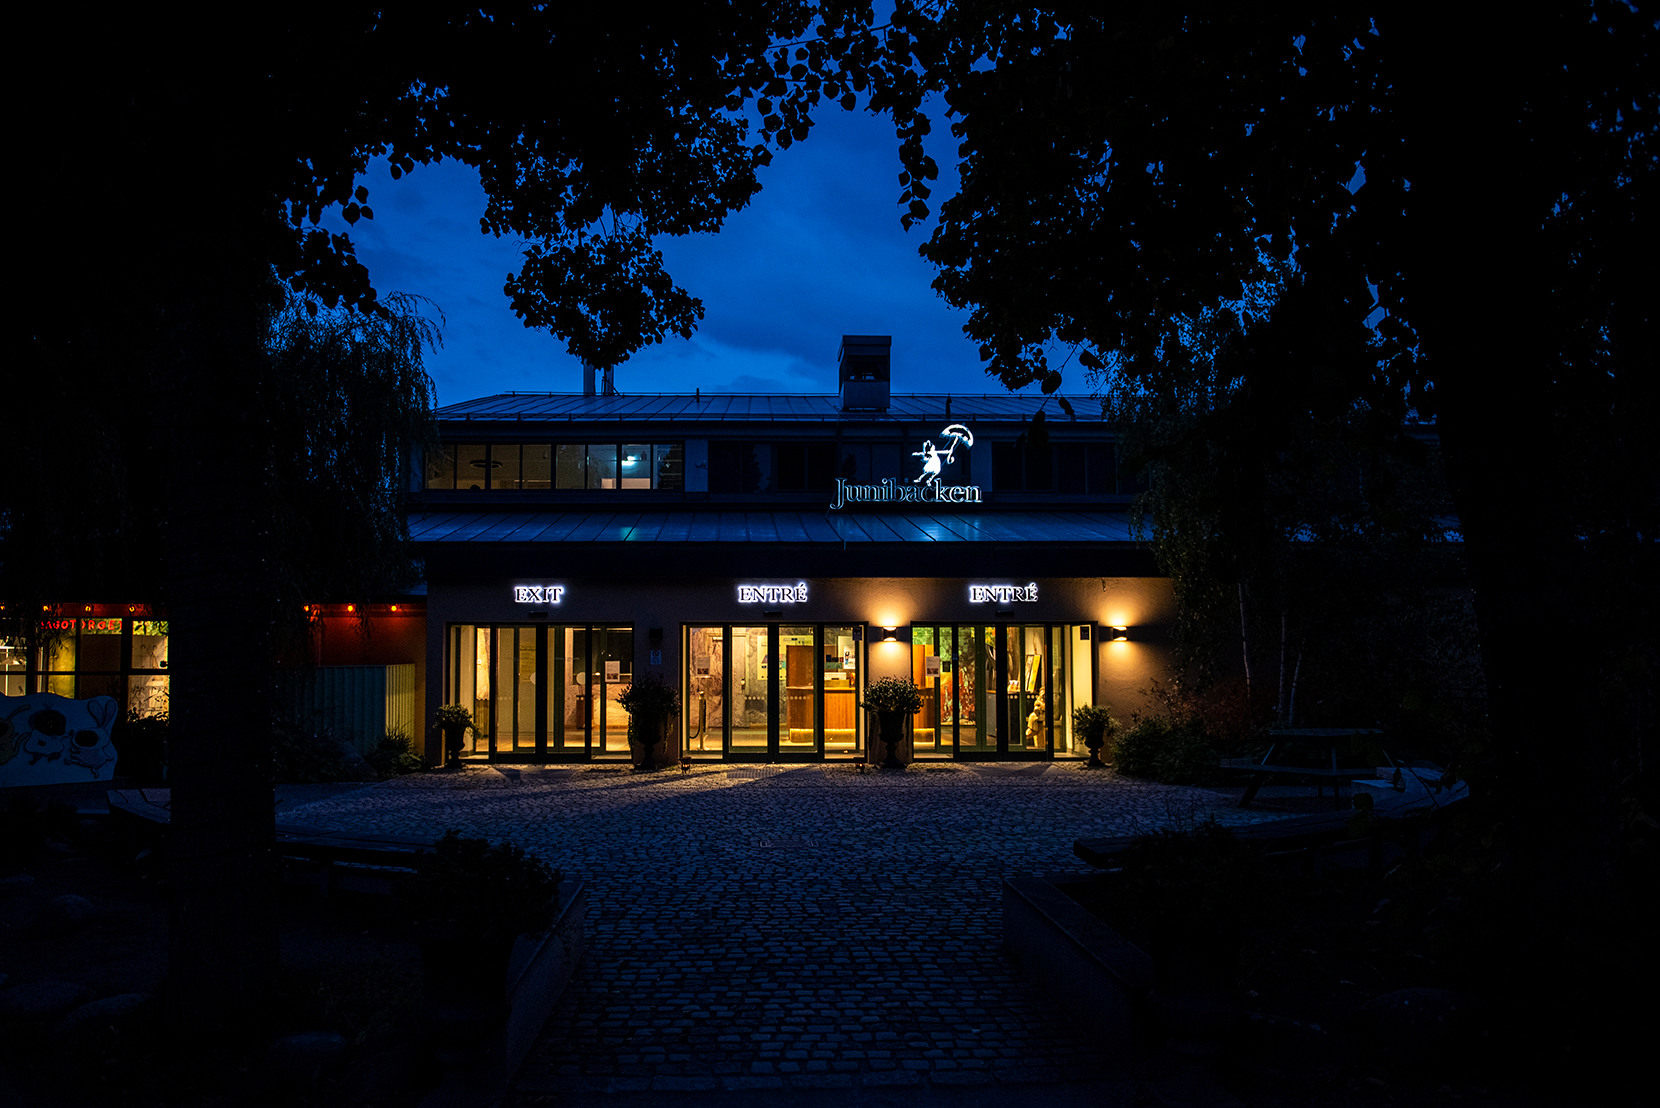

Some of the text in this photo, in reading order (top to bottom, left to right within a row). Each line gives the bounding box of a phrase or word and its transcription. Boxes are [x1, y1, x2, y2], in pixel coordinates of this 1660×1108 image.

[829, 478, 982, 509] Junibacken
[514, 586, 563, 603] EXIT
[738, 583, 807, 604] ENTRÉ
[969, 583, 1038, 604] ENTRÉ
